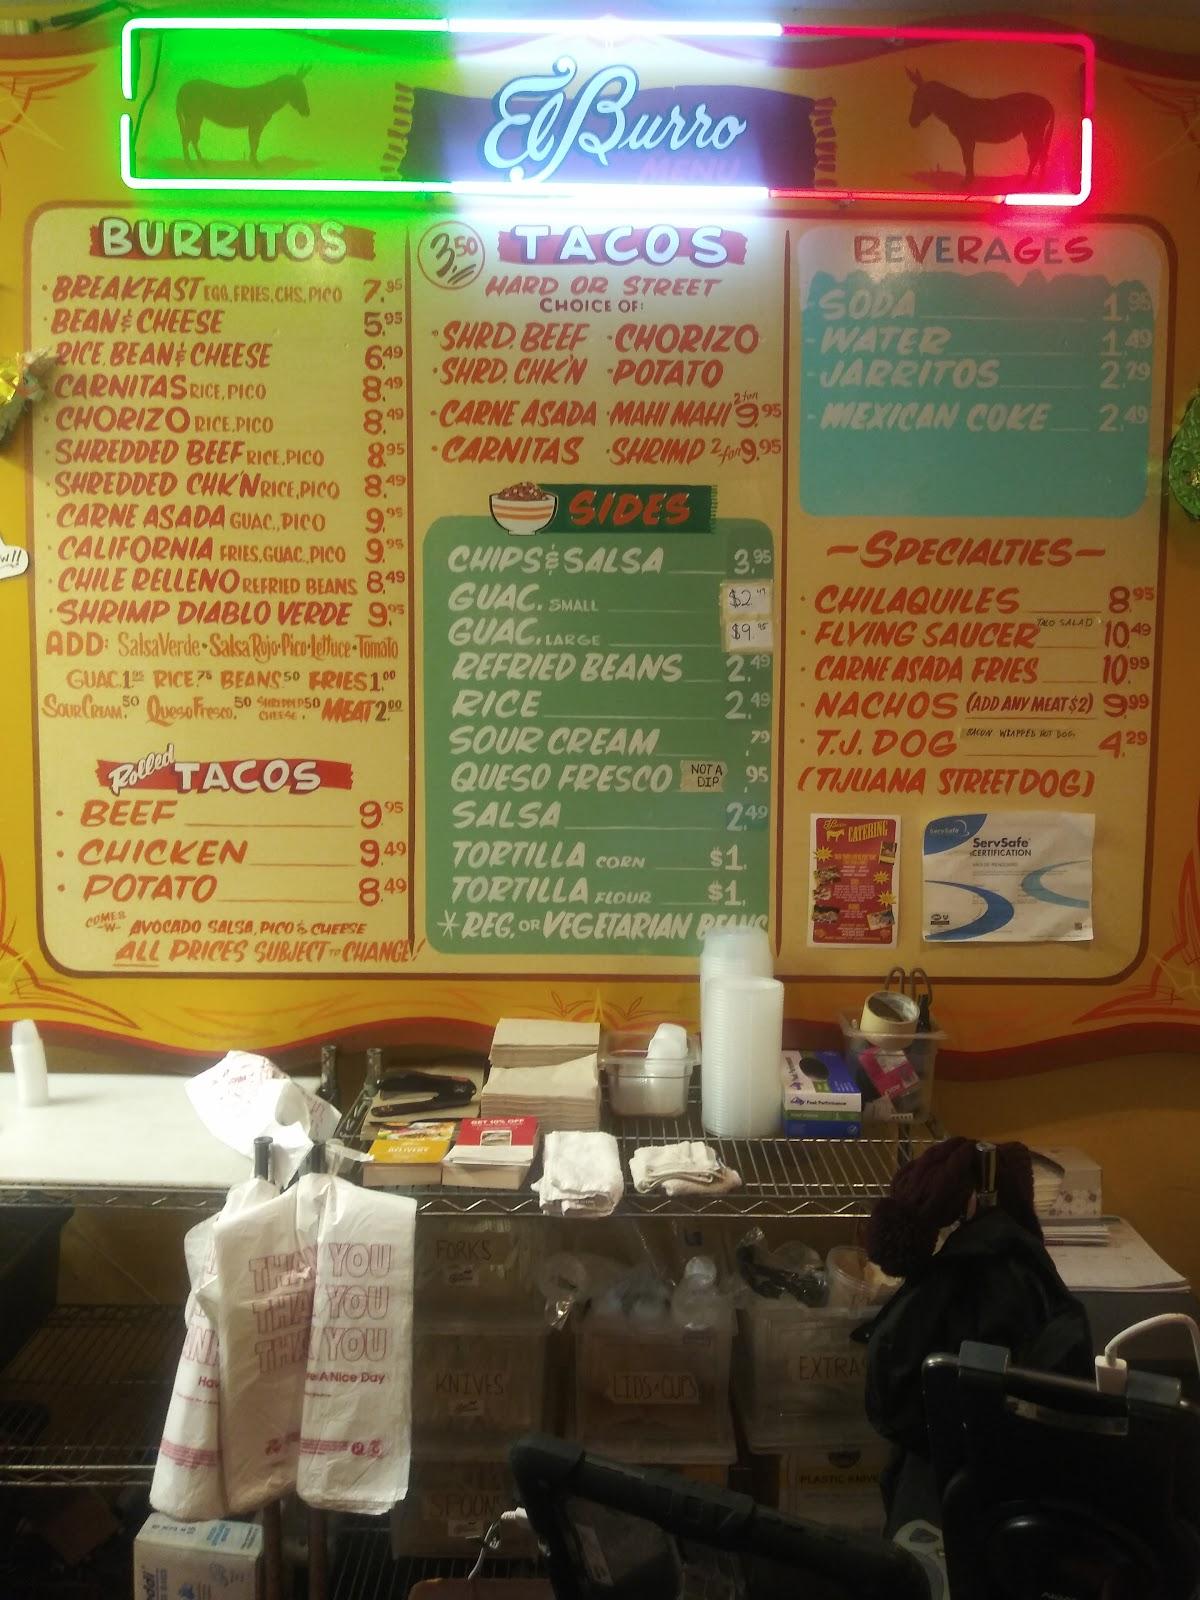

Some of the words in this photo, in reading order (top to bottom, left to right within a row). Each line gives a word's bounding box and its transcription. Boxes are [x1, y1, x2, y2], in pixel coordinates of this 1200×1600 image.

[484, 56, 577, 169] El
[567, 64, 746, 183] Burro
[102, 217, 347, 260] BURRITOS
[512, 224, 729, 268] TACOS
[854, 235, 1093, 265] BEVERAGES
[52, 275, 205, 302] BREAKFAST
[485, 275, 559, 297] HARD
[570, 276, 608, 297] OR
[623, 276, 722, 297] STREET
[540, 298, 612, 313] CHOICE
[618, 299, 644, 313] OF:
[818, 289, 915, 320] SODA
[51, 308, 121, 334] BEAN
[137, 309, 225, 334] CHEESE
[441, 321, 516, 351] SHRD.
[520, 322, 590, 351] BEEF
[615, 324, 759, 354] CHORIZO
[822, 327, 951, 356] WATER
[441, 357, 507, 385] SHRD.
[513, 354, 588, 386] CHK'N
[612, 359, 723, 388] POTATO
[820, 358, 1000, 390] JARRITOS
[55, 374, 188, 400] CARNITAS
[56, 406, 190, 434] CHORIZO
[439, 399, 519, 427] CARNE
[521, 400, 597, 427] ASADA
[609, 401, 669, 426] MAHI
[669, 401, 732, 427] MAHI
[820, 402, 960, 432] MEXICAN
[967, 403, 1051, 432] COKE
[56, 439, 179, 465] SHREDDED
[187, 440, 245, 465] BEEF
[442, 436, 584, 465] CARNITAS
[609, 437, 705, 465] SHRIMP
[55, 472, 177, 497] SHREDDED
[187, 469, 261, 498] CHK'N
[57, 503, 139, 529] CARNE
[143, 505, 225, 529] ASADA
[569, 490, 690, 526] SIDES
[58, 536, 213, 562] CALIFORNIA
[448, 545, 543, 574] CHIPS
[563, 548, 664, 574] SALSA
[860, 530, 1073, 568] SPECIALTIES
[58, 567, 128, 593] CHILE
[132, 568, 240, 593] RELLENO
[242, 578, 300, 594] REFRIED
[306, 578, 358, 595] BEANS
[448, 582, 542, 612] GUAC.
[549, 599, 598, 612] SMALL
[814, 584, 1020, 615] CHILAQUILES
[57, 600, 171, 625] SHRIMP
[177, 601, 271, 626] DIABLO
[278, 602, 352, 626] VERDE
[1059, 617, 1093, 627] SALAD
[46, 632, 108, 656] ADD:
[356, 634, 399, 659] Tomato
[448, 617, 541, 646] GUAC.
[545, 634, 600, 646] LARGE
[814, 621, 918, 648] FLYING
[922, 622, 1040, 648] SAUCER
[309, 670, 368, 690] FRIES
[452, 653, 576, 681] REFRIED
[580, 654, 683, 682] BEANS
[814, 656, 892, 682] CARNE
[892, 657, 962, 682] ASADA
[971, 657, 1039, 684] FRIES
[322, 698, 375, 723] MEAT
[452, 689, 542, 718] RICE
[814, 692, 959, 719] NACHOS
[1000, 696, 1031, 711] ANY
[1031, 697, 1068, 712] MEAT
[449, 726, 544, 755] SOUR
[548, 728, 660, 756] CREAM
[872, 729, 958, 758] DOG
[109, 743, 175, 796] Rolled
[175, 760, 321, 795] TACOS
[451, 762, 552, 792] QUESO
[558, 764, 672, 792] FRESCO
[691, 763, 714, 776] NOT
[715, 766, 723, 776] A
[697, 776, 719, 788] DIP
[937, 769, 1021, 795] STREET
[80, 800, 177, 827] BEEF
[452, 801, 562, 828] SALSA
[78, 839, 248, 866] CHICKEN
[452, 842, 586, 869] TORTILLA
[596, 856, 645, 869] CORN
[972, 837, 1028, 848] ServSafe
[83, 874, 217, 903] POTATO
[452, 877, 588, 904] TORTILLA
[594, 891, 651, 905] FLOUR
[129, 920, 201, 936] AVOCADO
[260, 922, 294, 935] PICO
[311, 922, 367, 935] CHEESE
[519, 919, 540, 931] OR
[542, 911, 693, 939] VEGETARIAN
[115, 940, 160, 962] ALL
[168, 940, 248, 962] PRICES
[254, 940, 329, 962] SUBJECT
[328, 1242, 392, 1278] YOU
[435, 1239, 491, 1261] FORKS
[326, 1284, 390, 1320] YOU
[324, 1327, 388, 1362] YOU
[199, 1376, 220, 1388] Hav
[319, 1373, 329, 1383] A
[330, 1372, 357, 1384] Nice
[360, 1372, 385, 1385] Day
